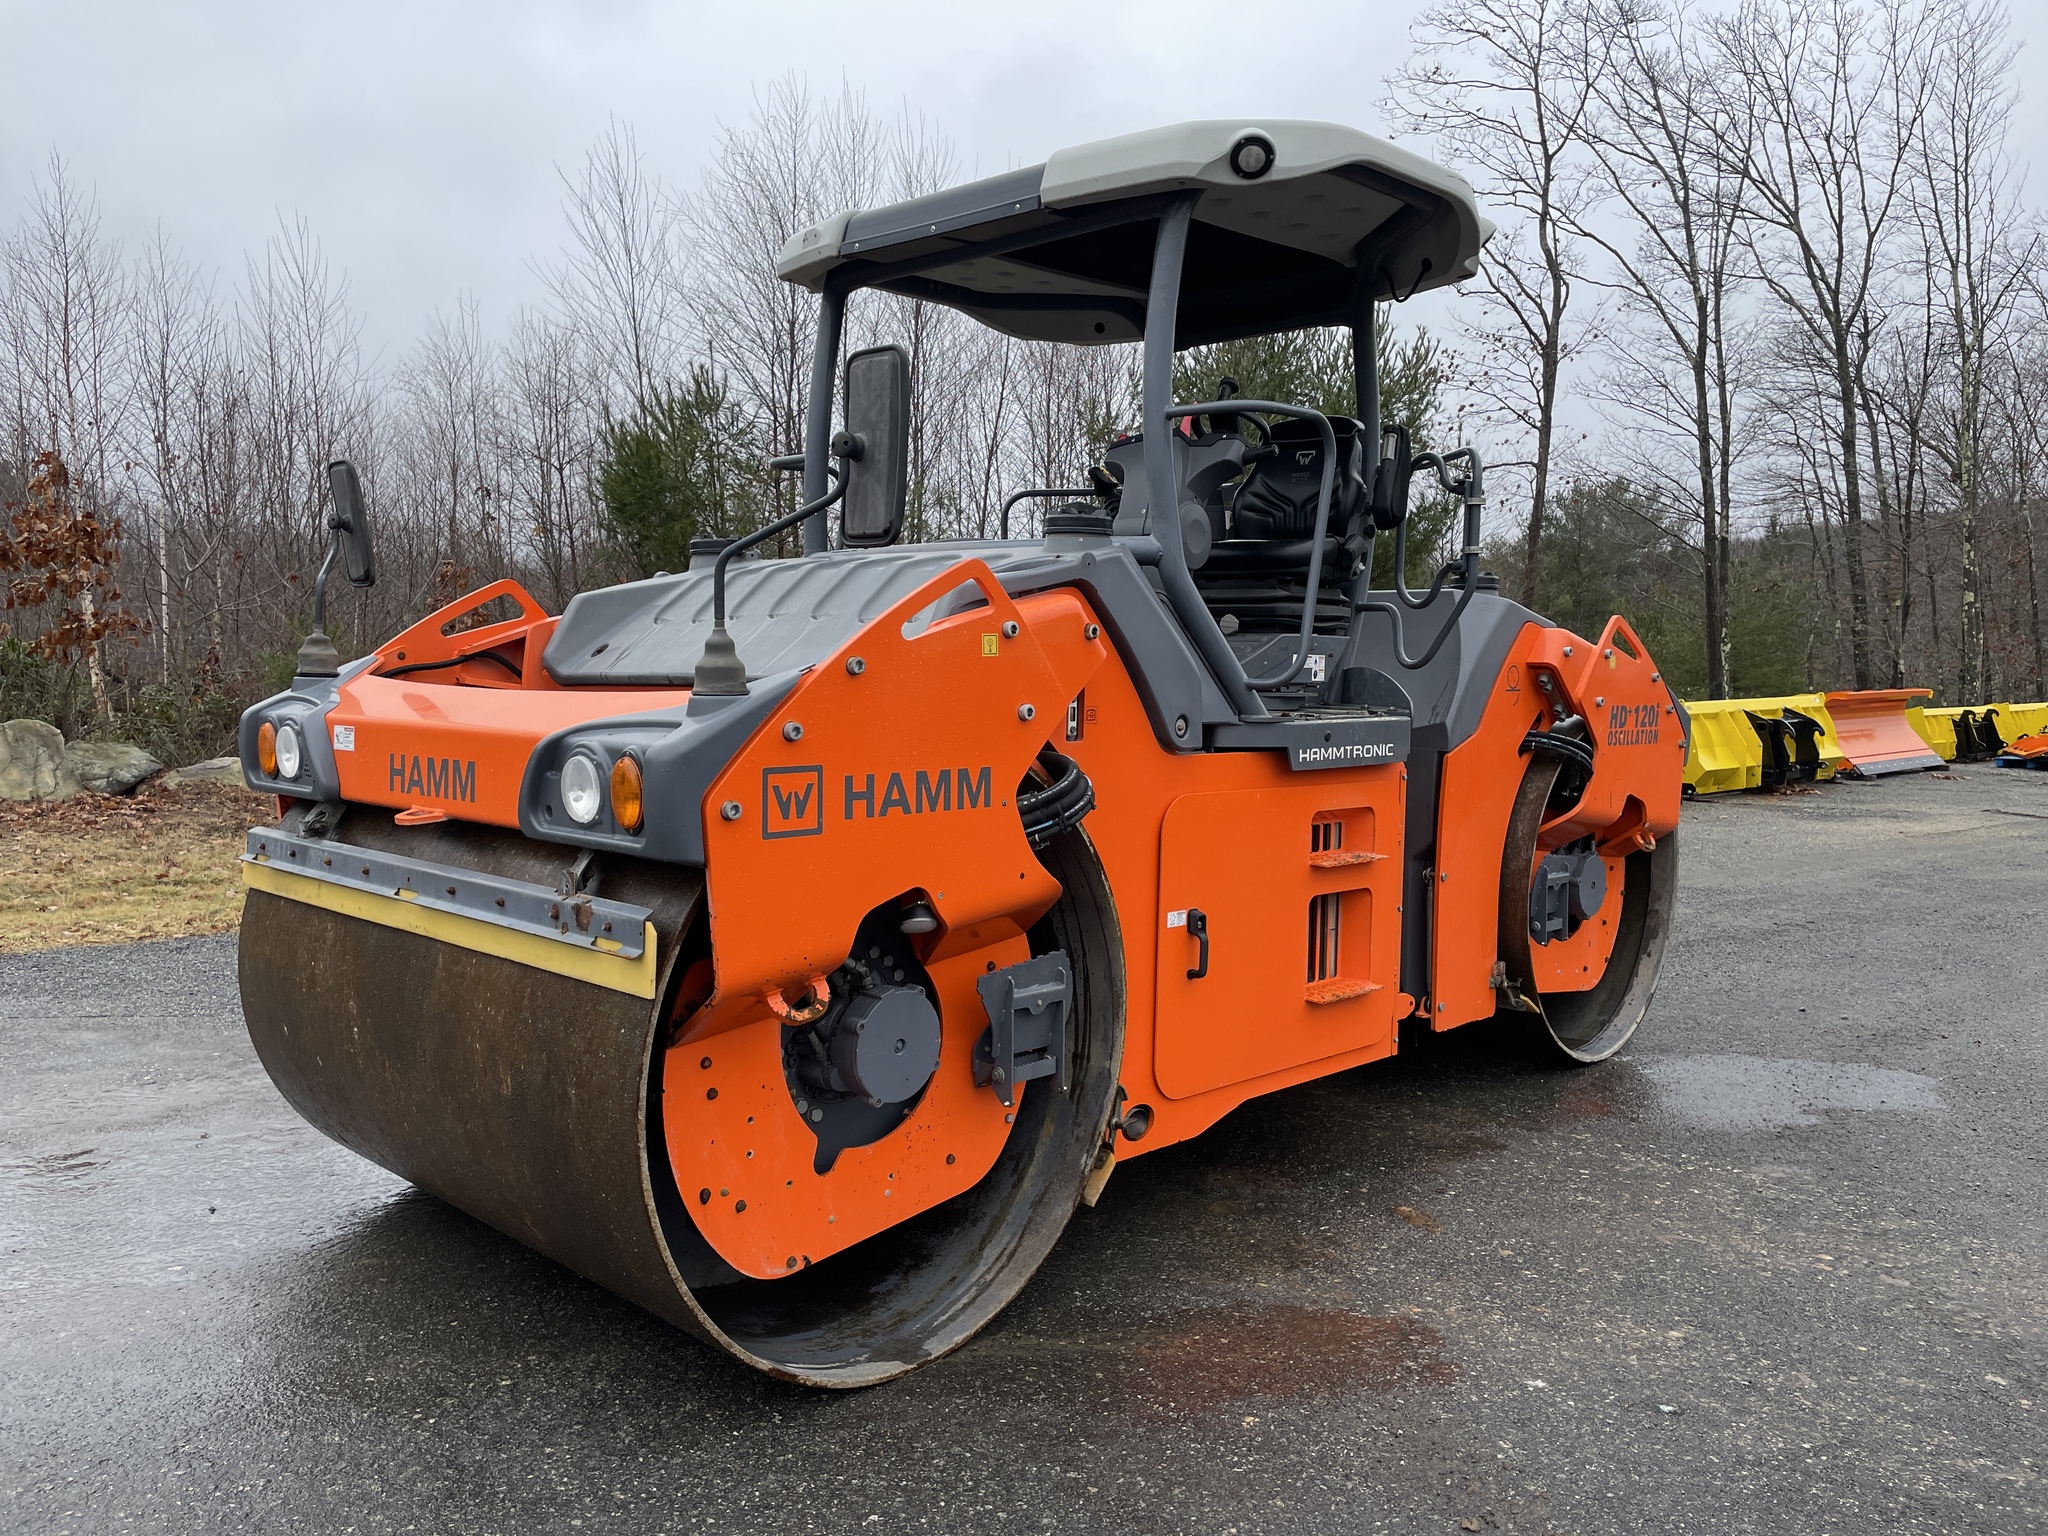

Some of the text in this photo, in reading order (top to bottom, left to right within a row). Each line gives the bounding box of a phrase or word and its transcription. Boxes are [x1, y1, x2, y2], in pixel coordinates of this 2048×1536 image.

[1299, 743, 1394, 763] HAMMTRONIC
[1607, 729, 1659, 747] OSCILLATION
[389, 753, 476, 803] HAMM
[844, 766, 992, 820] HAMM
